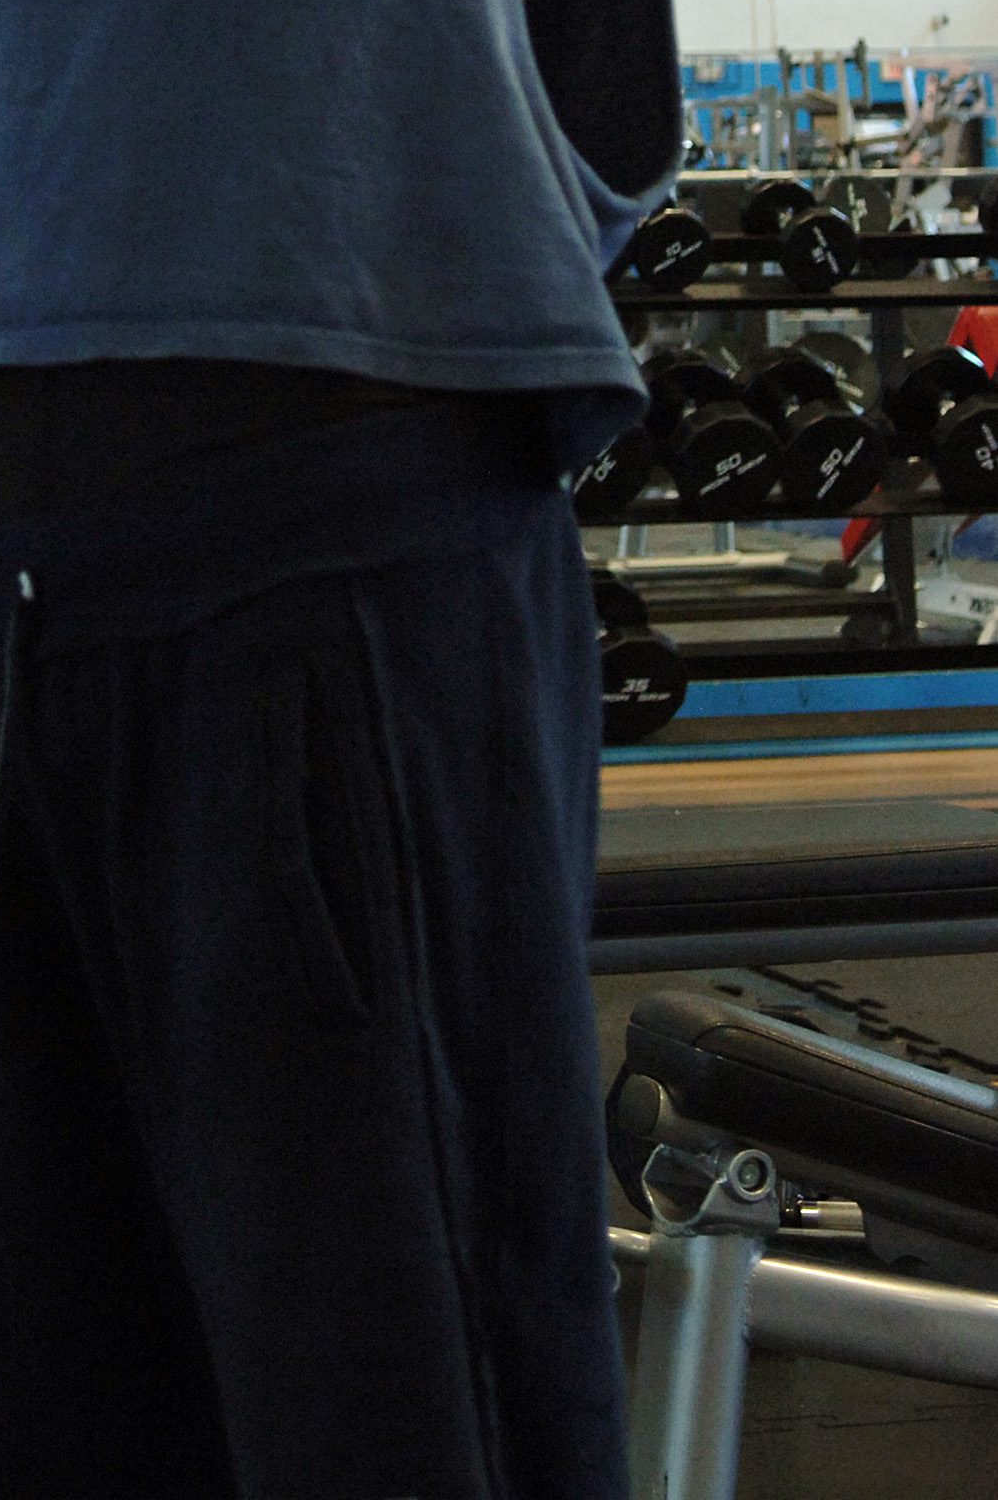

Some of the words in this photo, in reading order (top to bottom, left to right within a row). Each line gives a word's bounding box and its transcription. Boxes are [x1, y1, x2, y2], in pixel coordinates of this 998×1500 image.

[593, 457, 617, 483] 30
[714, 452, 743, 476] 50
[819, 447, 844, 478] 50
[619, 677, 653, 694] 35
